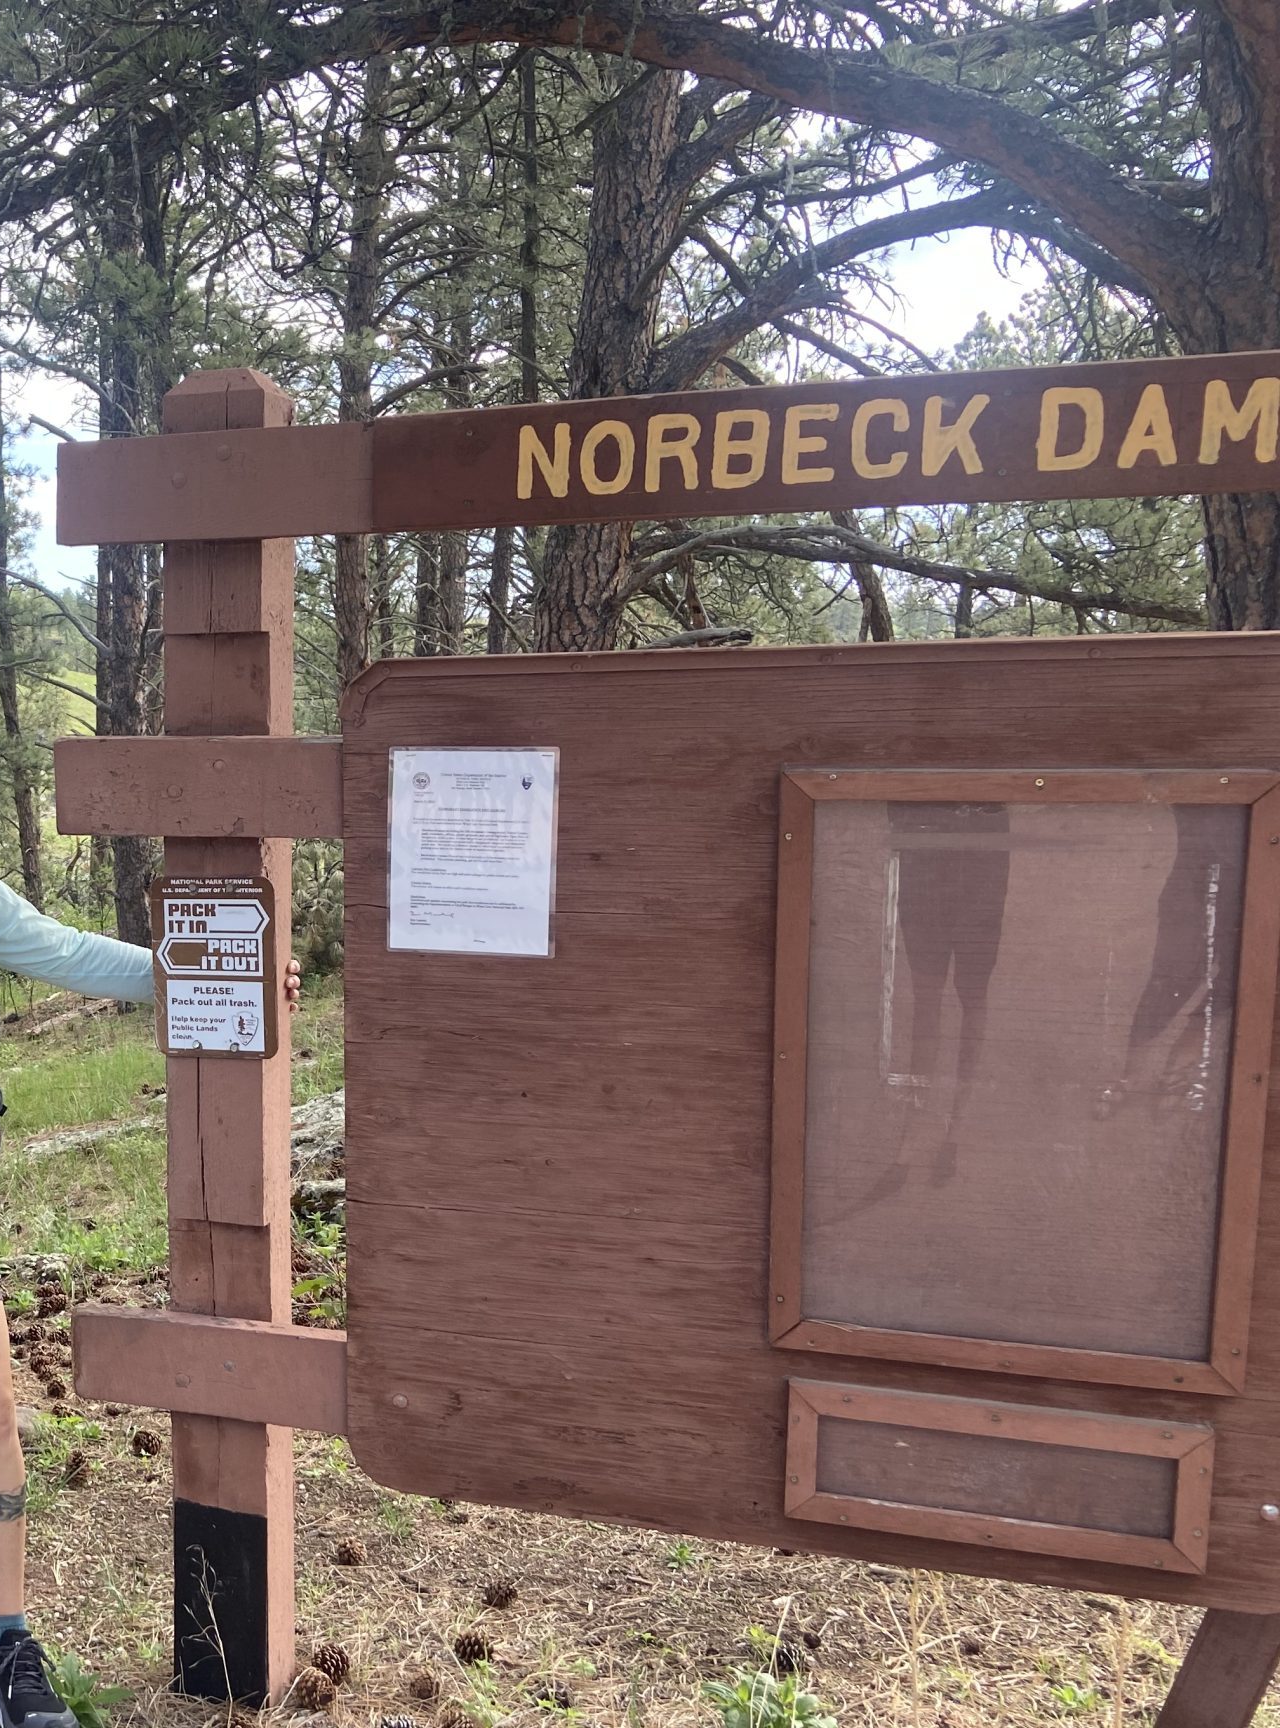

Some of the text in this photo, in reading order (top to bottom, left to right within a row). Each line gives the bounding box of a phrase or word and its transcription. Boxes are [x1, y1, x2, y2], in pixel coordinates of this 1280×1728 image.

[518, 377, 1280, 499] NORBECK DAM
[168, 904, 216, 916] PACK
[169, 920, 185, 933] IT
[208, 940, 257, 953] PACK
[202, 957, 258, 971] IT OUT
[230, 999, 257, 1007] trash.
